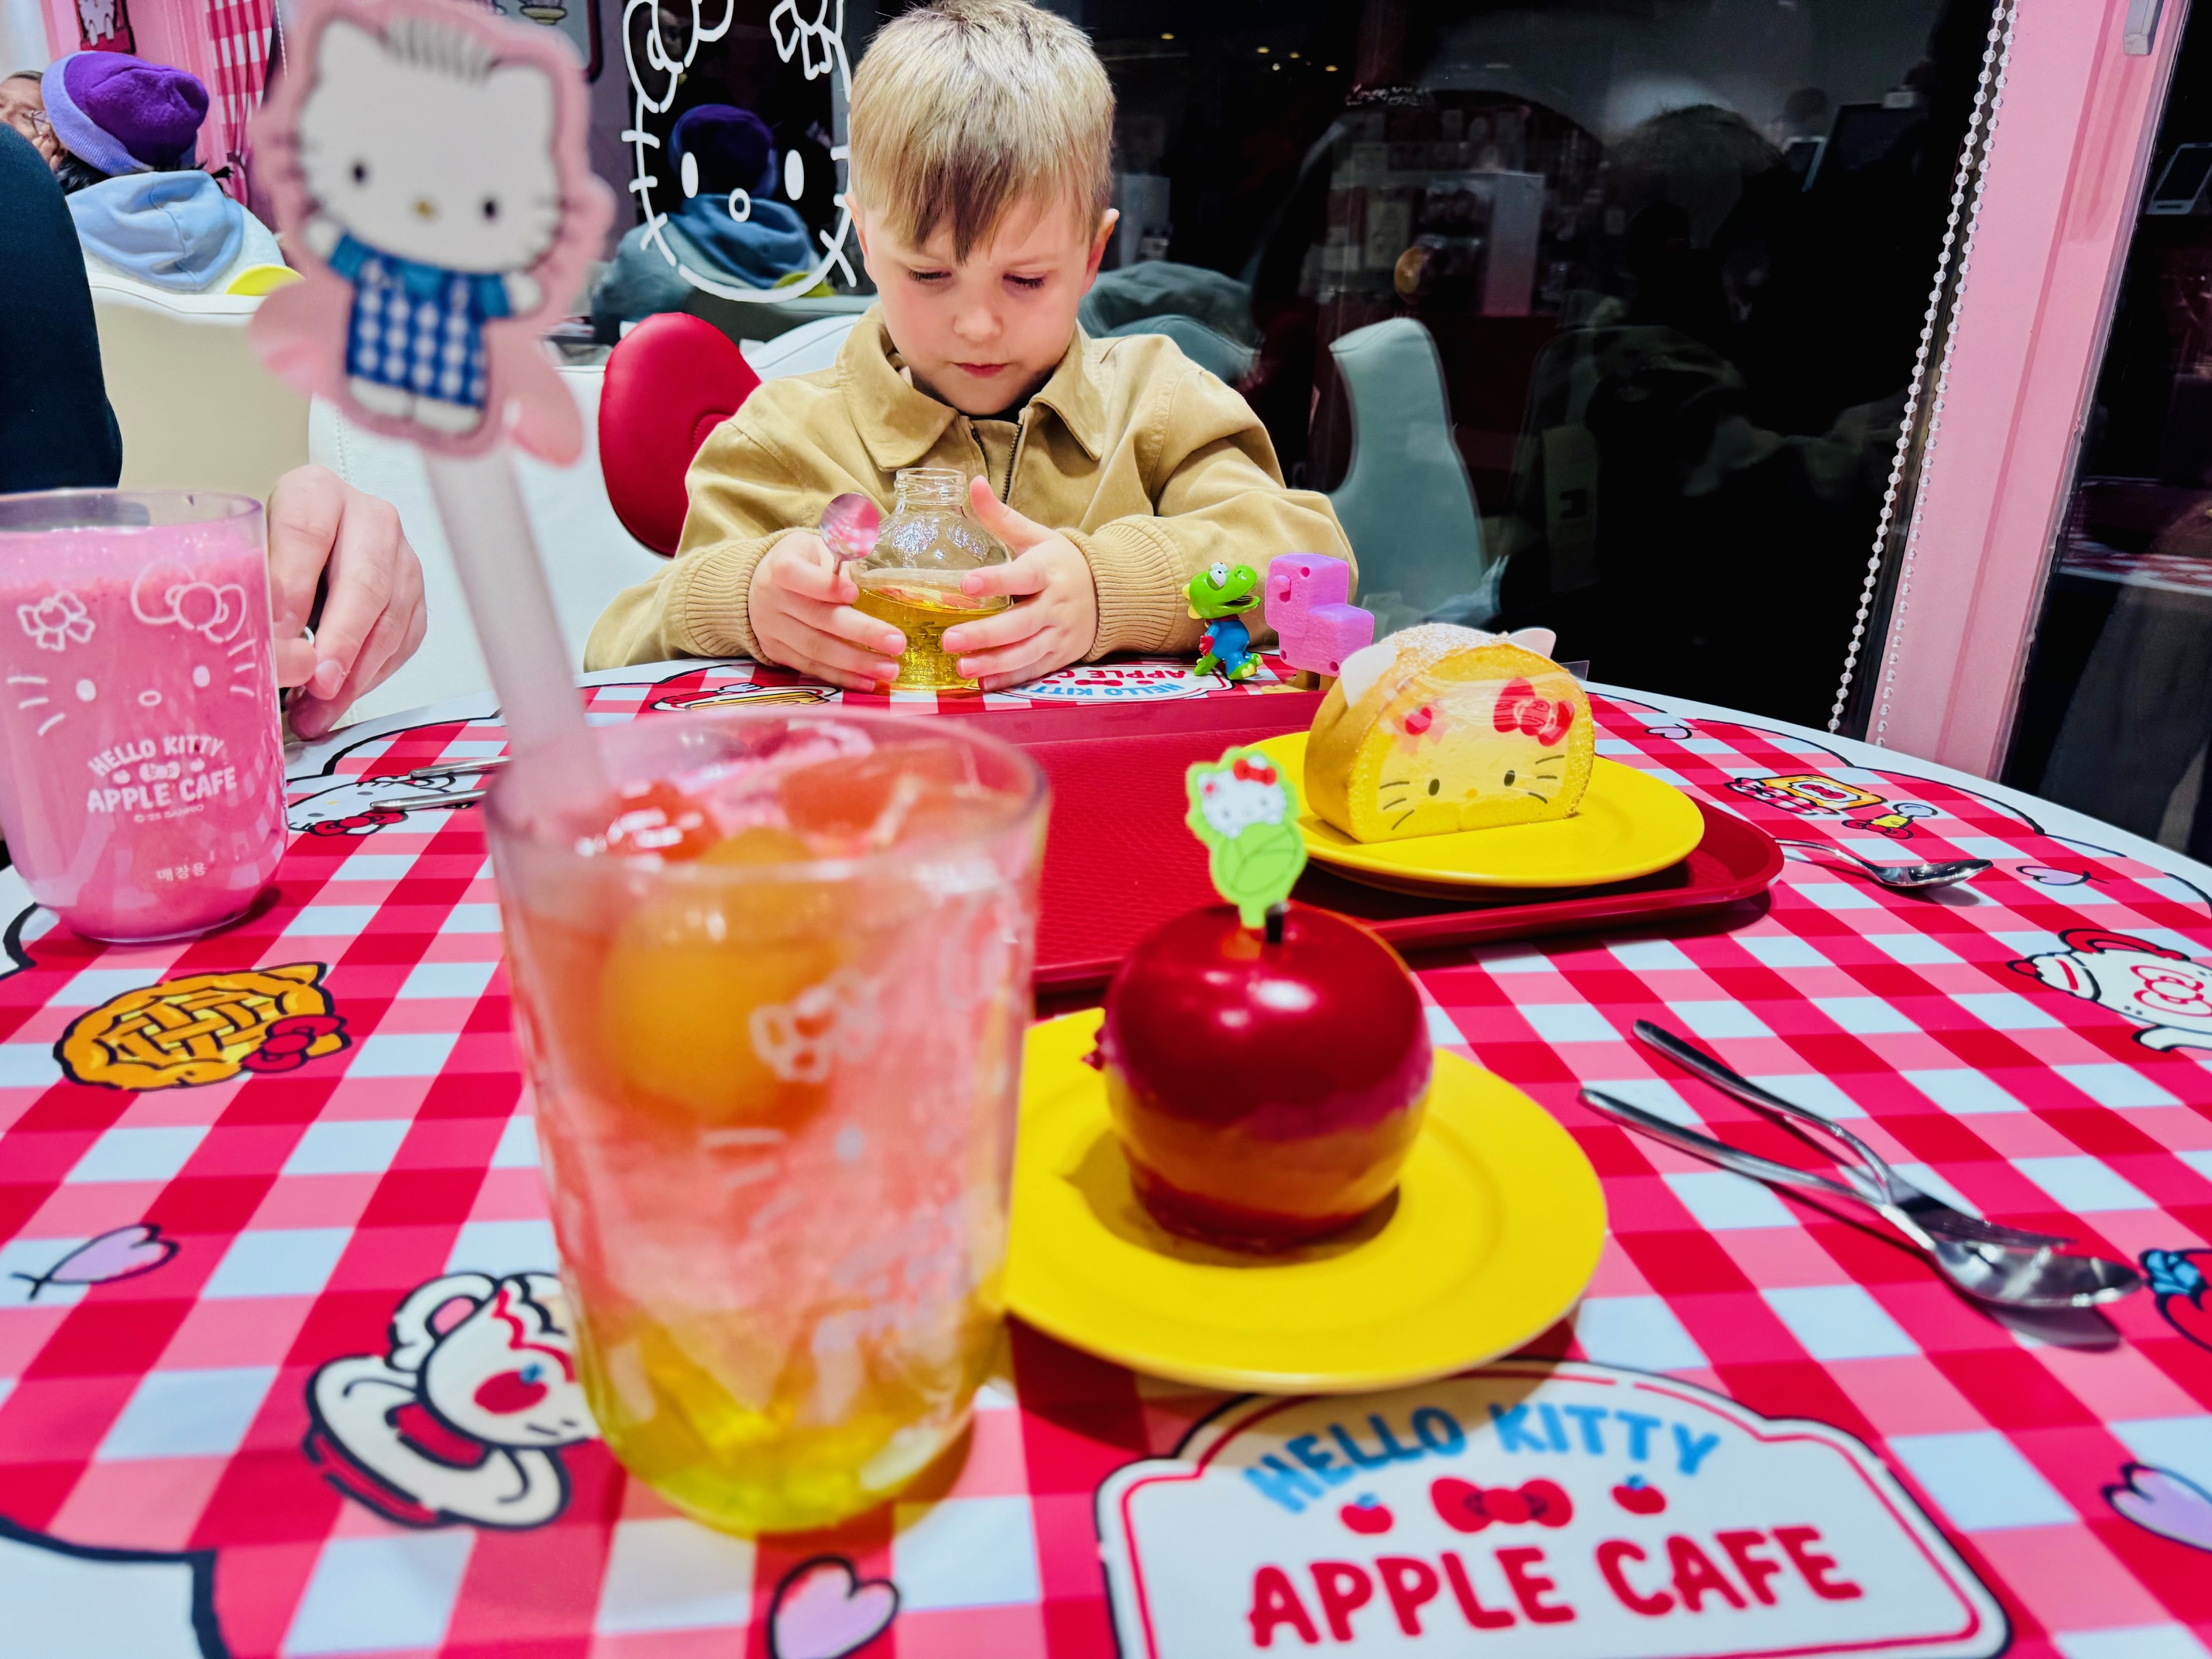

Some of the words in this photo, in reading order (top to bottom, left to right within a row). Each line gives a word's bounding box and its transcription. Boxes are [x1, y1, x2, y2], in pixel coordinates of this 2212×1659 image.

[1087, 670, 1185, 678] APPLE
[1105, 682, 1185, 696] HELLO
[88, 740, 156, 777] HELLO
[163, 735, 225, 757] KITTY
[88, 783, 172, 812] APPLE
[179, 766, 237, 802] CAFE
[156, 862, 206, 881] 매장용
[1243, 1405, 1467, 1513] HELLO
[1489, 1403, 1721, 1475] KITTY
[1247, 1546, 1577, 1648] APPLE
[1593, 1527, 1863, 1617] CAFE
